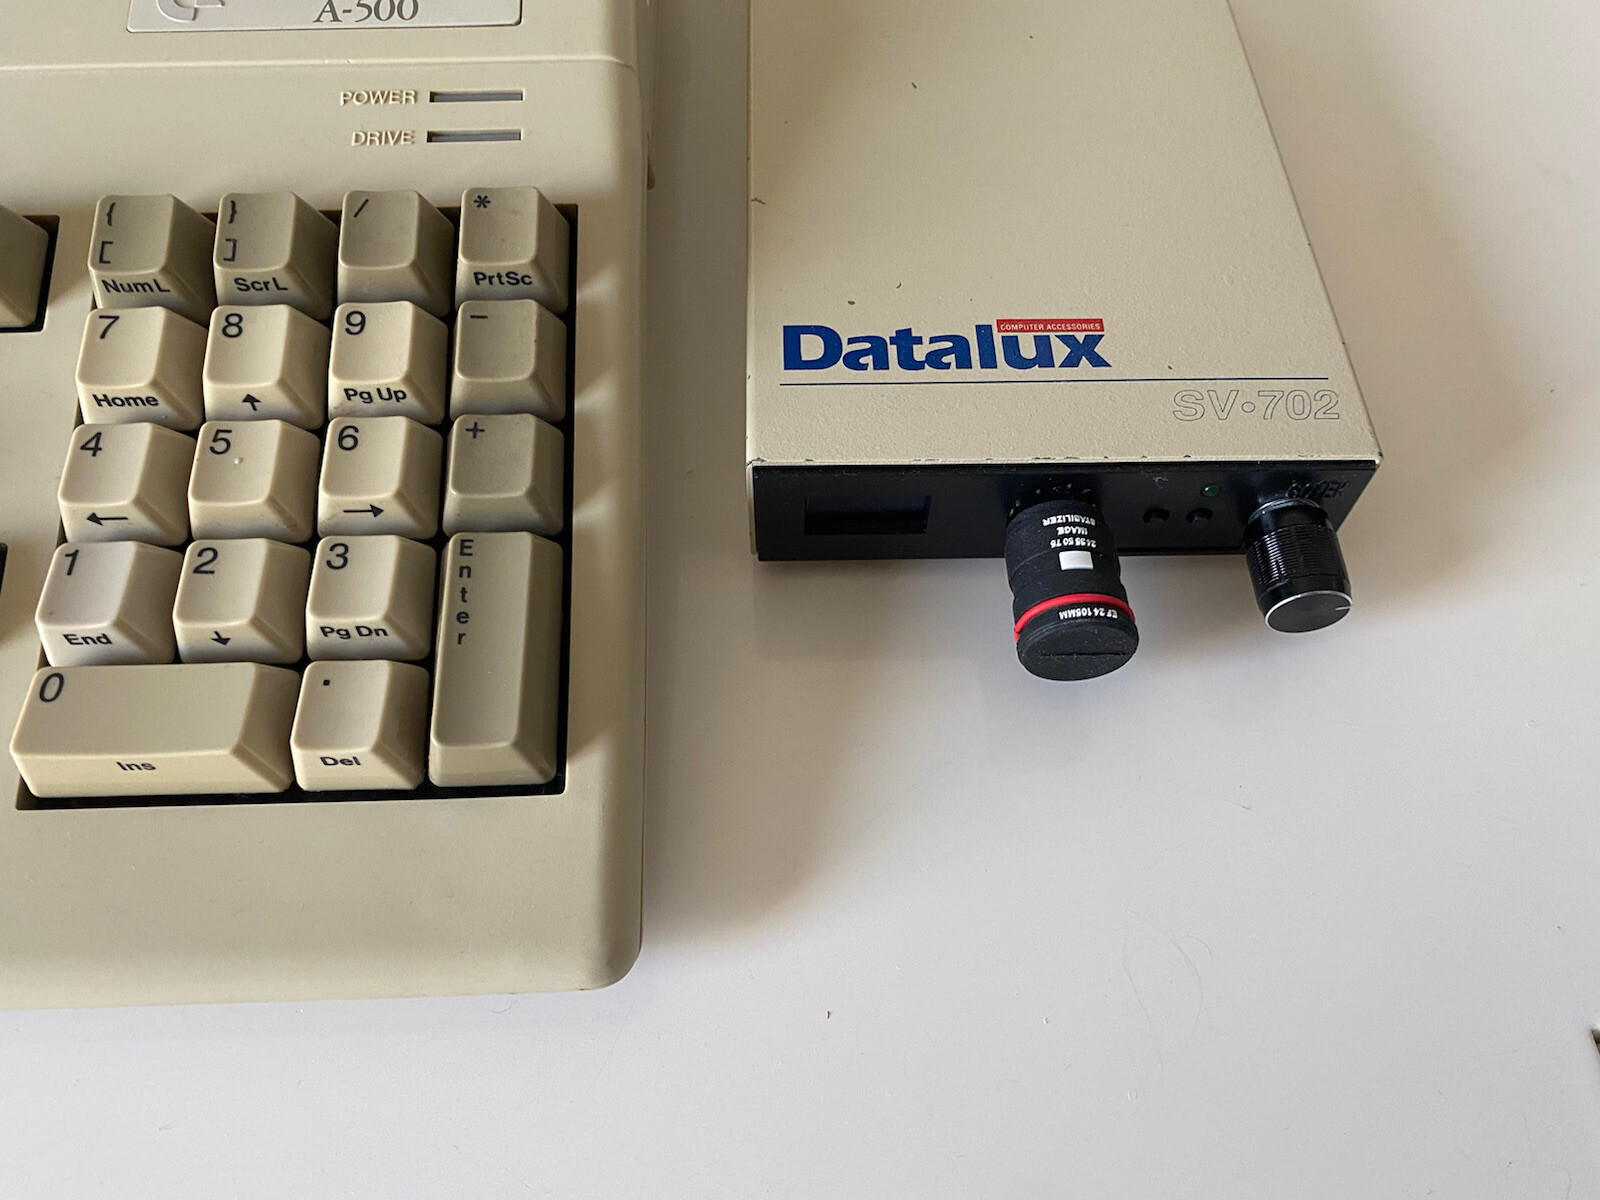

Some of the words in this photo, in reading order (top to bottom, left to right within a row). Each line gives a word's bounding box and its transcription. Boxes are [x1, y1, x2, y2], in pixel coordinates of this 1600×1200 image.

[313, 0, 418, 23] A-500
[340, 89, 417, 106] POWER
[351, 130, 414, 147] DRIVE
[473, 271, 533, 286] PrtSc
[98, 315, 120, 339] 7
[222, 312, 244, 338] 8
[344, 311, 366, 336] 9
[1000, 323, 1045, 331] COMPUTER
[1046, 322, 1101, 331] ACCESSORIES
[783, 324, 1113, 370] Datalux
[93, 392, 160, 408] Home
[343, 387, 373, 404] Pg
[376, 387, 407, 403] Up
[80, 432, 102, 457] 4
[209, 429, 233, 455] 5
[337, 425, 360, 452] 6
[1042, 514, 1096, 527] STABILIZER
[1056, 525, 1088, 536] IMAGE
[65, 549, 80, 577] 1
[193, 546, 219, 575] 2
[326, 543, 350, 570] 3
[456, 538, 475, 646] Enter
[1106, 608, 1118, 619] EF
[62, 632, 114, 646] End
[319, 626, 352, 640] Pg
[355, 625, 389, 637] Dn
[38, 672, 65, 703] 0
[116, 761, 157, 772] Ins
[319, 756, 362, 767] Del
